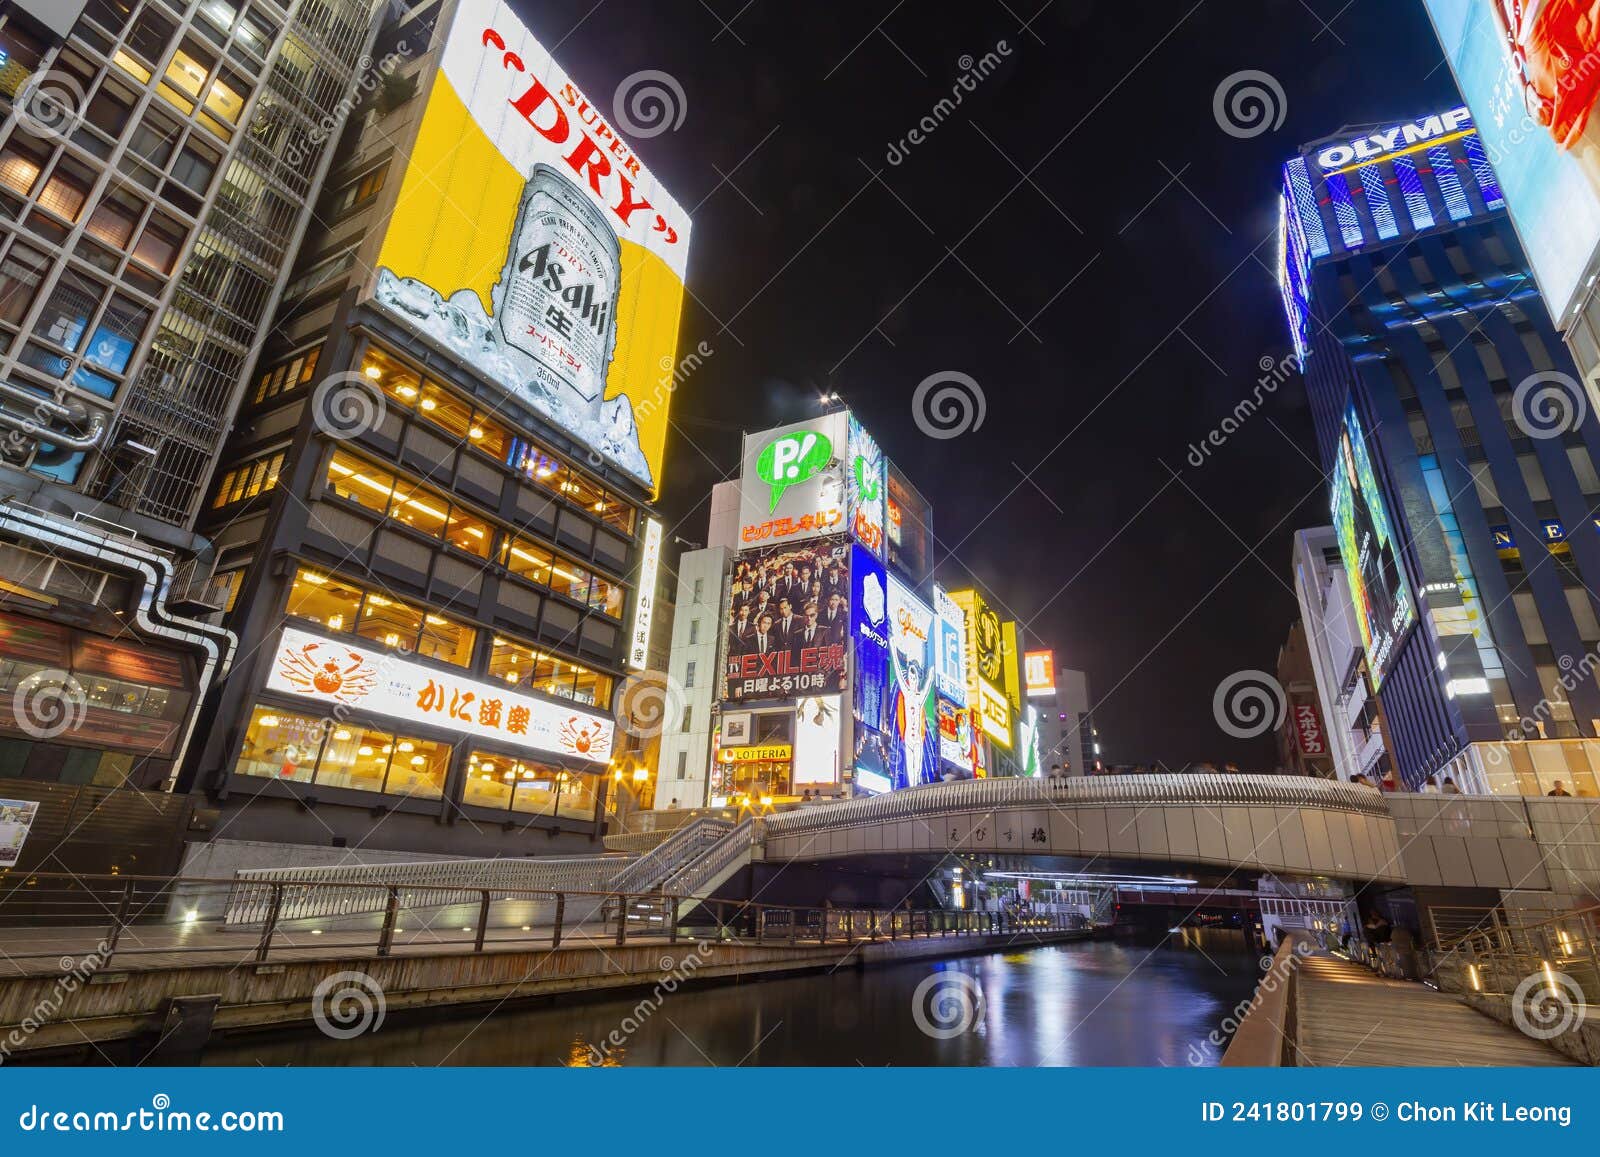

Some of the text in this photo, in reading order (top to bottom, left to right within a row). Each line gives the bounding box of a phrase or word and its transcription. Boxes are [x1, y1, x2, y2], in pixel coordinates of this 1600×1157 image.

[560, 83, 641, 179] SUPER
[519, 243, 607, 336] Asahi
[545, 304, 573, 342] 生
[526, 324, 582, 373] スーパードライ
[536, 366, 561, 391] 350ml
[773, 433, 817, 480] P!
[743, 674, 825, 694] 日曜よる10時
[1297, 705, 1321, 753] スポタカ
[736, 748, 787, 760] LOTTERIA
